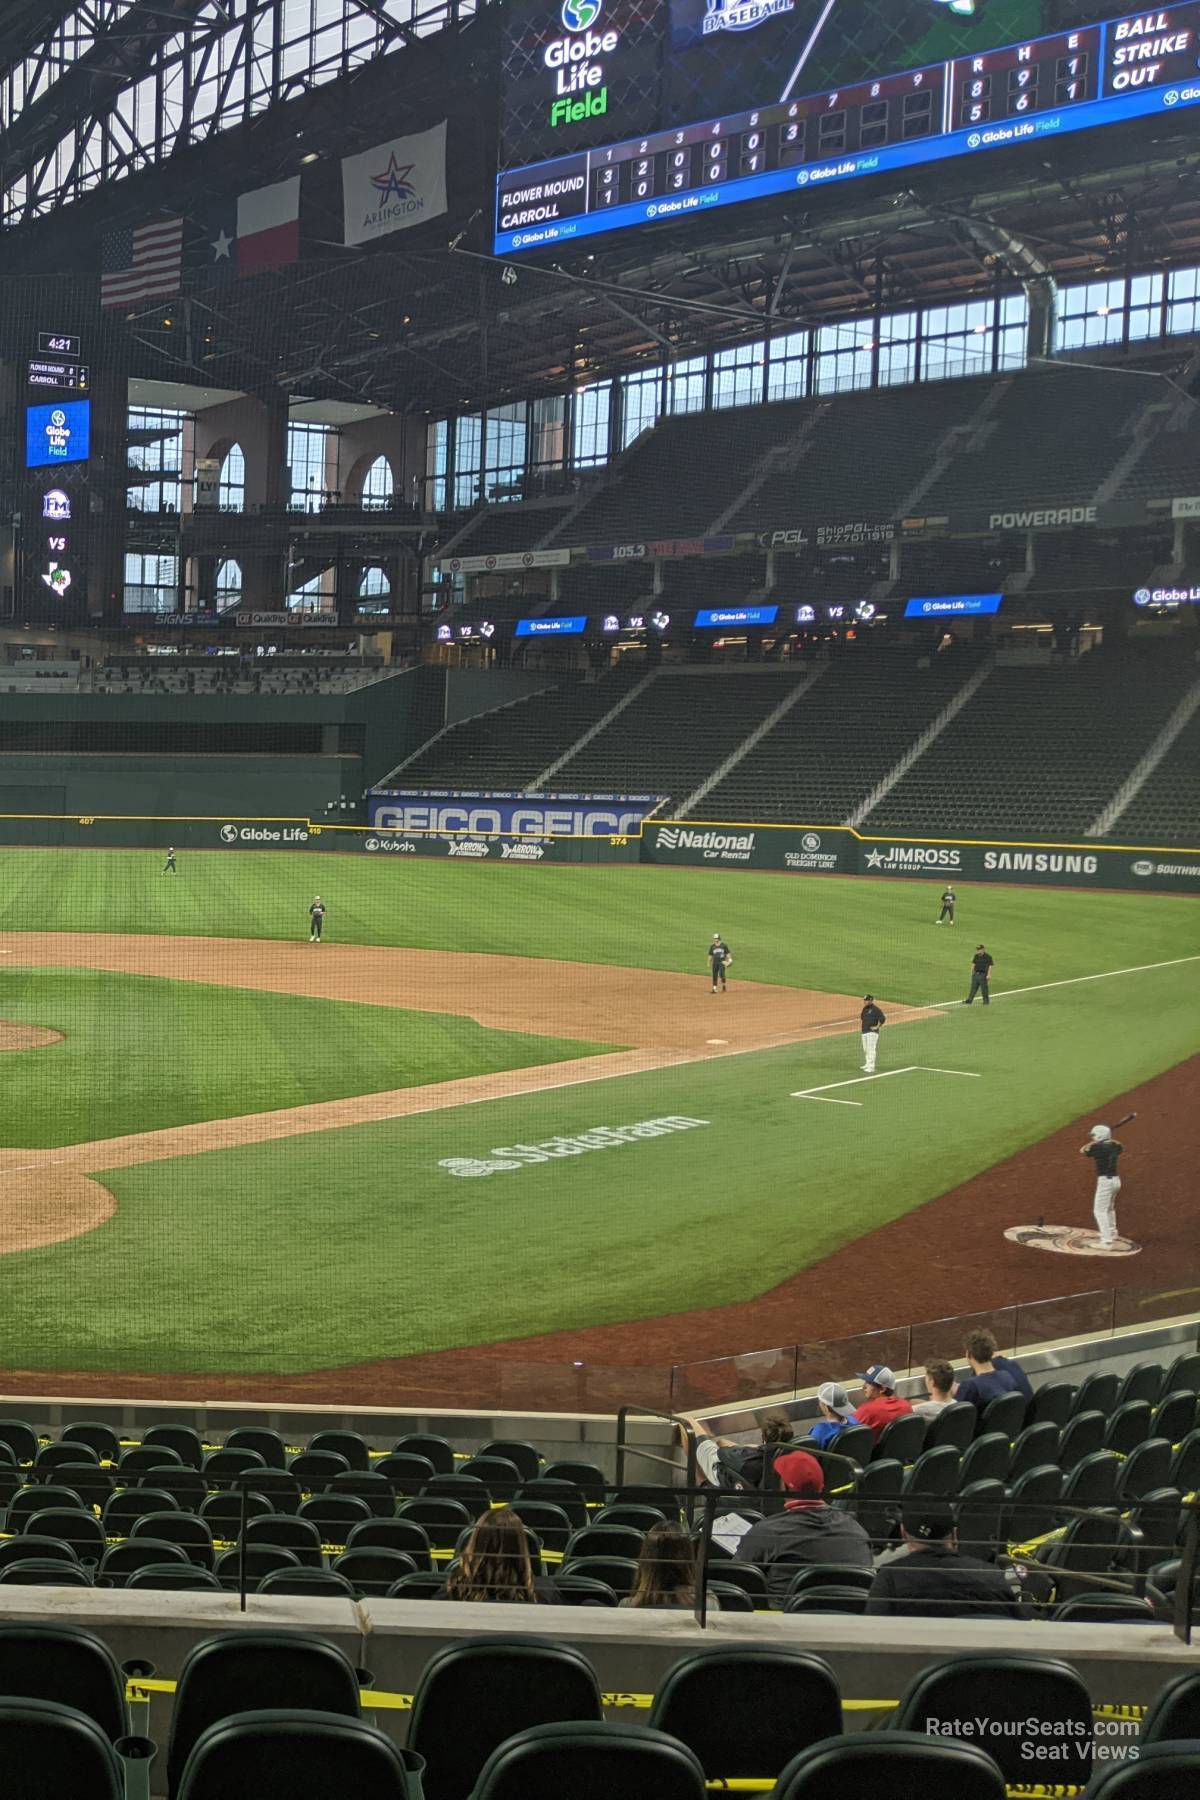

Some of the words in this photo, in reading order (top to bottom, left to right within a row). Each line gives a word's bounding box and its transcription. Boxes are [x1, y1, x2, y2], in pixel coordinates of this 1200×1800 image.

[703, 0, 794, 33] BASEBALL
[1115, 13, 1168, 40] BALL
[544, 31, 618, 68] Globe
[1113, 33, 1189, 65] STRIKE
[556, 61, 602, 96] Life
[1112, 65, 1160, 89] OUT
[551, 87, 608, 127] Field
[605, 150, 612, 161] 1
[639, 142, 648, 153] 2
[676, 132, 684, 143] 3
[712, 123, 721, 135] 4
[750, 114, 759, 126] 5
[788, 104, 798, 116] 6
[829, 94, 839, 107] 7
[870, 83, 881, 97] 8
[913, 74, 923, 86] 9
[973, 59, 984, 72] R
[1018, 47, 1031, 61] H
[1068, 35, 1079, 48] E
[502, 184, 542, 208] FLOWER
[544, 176, 584, 198] MOUND
[604, 170, 612, 183] 3
[638, 162, 647, 175] 2
[674, 153, 684, 167] 0
[711, 145, 720, 158] 0
[749, 135, 759, 149] 0
[787, 125, 798, 139] 3
[971, 82, 983, 97] 8
[1018, 72, 1030, 86] 9
[1069, 58, 1078, 75] 1
[982, 128, 1012, 144] Globe
[1014, 124, 1034, 137] Life
[1035, 118, 1060, 132] Field
[502, 205, 559, 228] CARROLL
[604, 191, 611, 204] 1
[637, 182, 647, 196] 0
[673, 174, 683, 188] 3
[710, 166, 720, 179] 0
[749, 157, 757, 170] 1
[970, 106, 982, 120] 5
[1016, 96, 1027, 110] 6
[1067, 83, 1076, 99] 1
[810, 165, 836, 181] Globe
[838, 161, 855, 175] Life
[856, 157, 878, 172] Field
[363, 197, 424, 227] ARLINGTON
[658, 199, 681, 214] Globe
[683, 196, 698, 208] Life
[699, 192, 719, 205] Field
[522, 231, 543, 245] Globe
[544, 227, 558, 239] Life
[560, 224, 576, 236] Field
[49, 338, 71, 350] 4:21
[30, 375, 58, 384] CARROLL
[46, 426, 70, 437] Globe
[50, 436, 66, 446] Life
[48, 446, 67, 456] Field
[990, 506, 1097, 529] POWERADE
[772, 529, 808, 545] PGL
[613, 544, 646, 559] 105.3
[1152, 589, 1188, 602] Globe
[932, 602, 951, 610] Globe
[952, 601, 964, 609] Life
[79, 818, 94, 826] 407
[375, 806, 501, 842] GEICO
[240, 827, 281, 841] Globe
[282, 827, 308, 841] Life
[610, 838, 627, 846] 374
[381, 839, 416, 852] Kubota
[458, 842, 483, 852] ARROW
[512, 844, 537, 854] ARROW
[703, 850, 720, 858] Car
[721, 851, 750, 860] Rental
[786, 859, 817, 867] FREIGHT
[800, 853, 837, 861] DOMINION
[984, 852, 1098, 874] SAMSUNG
